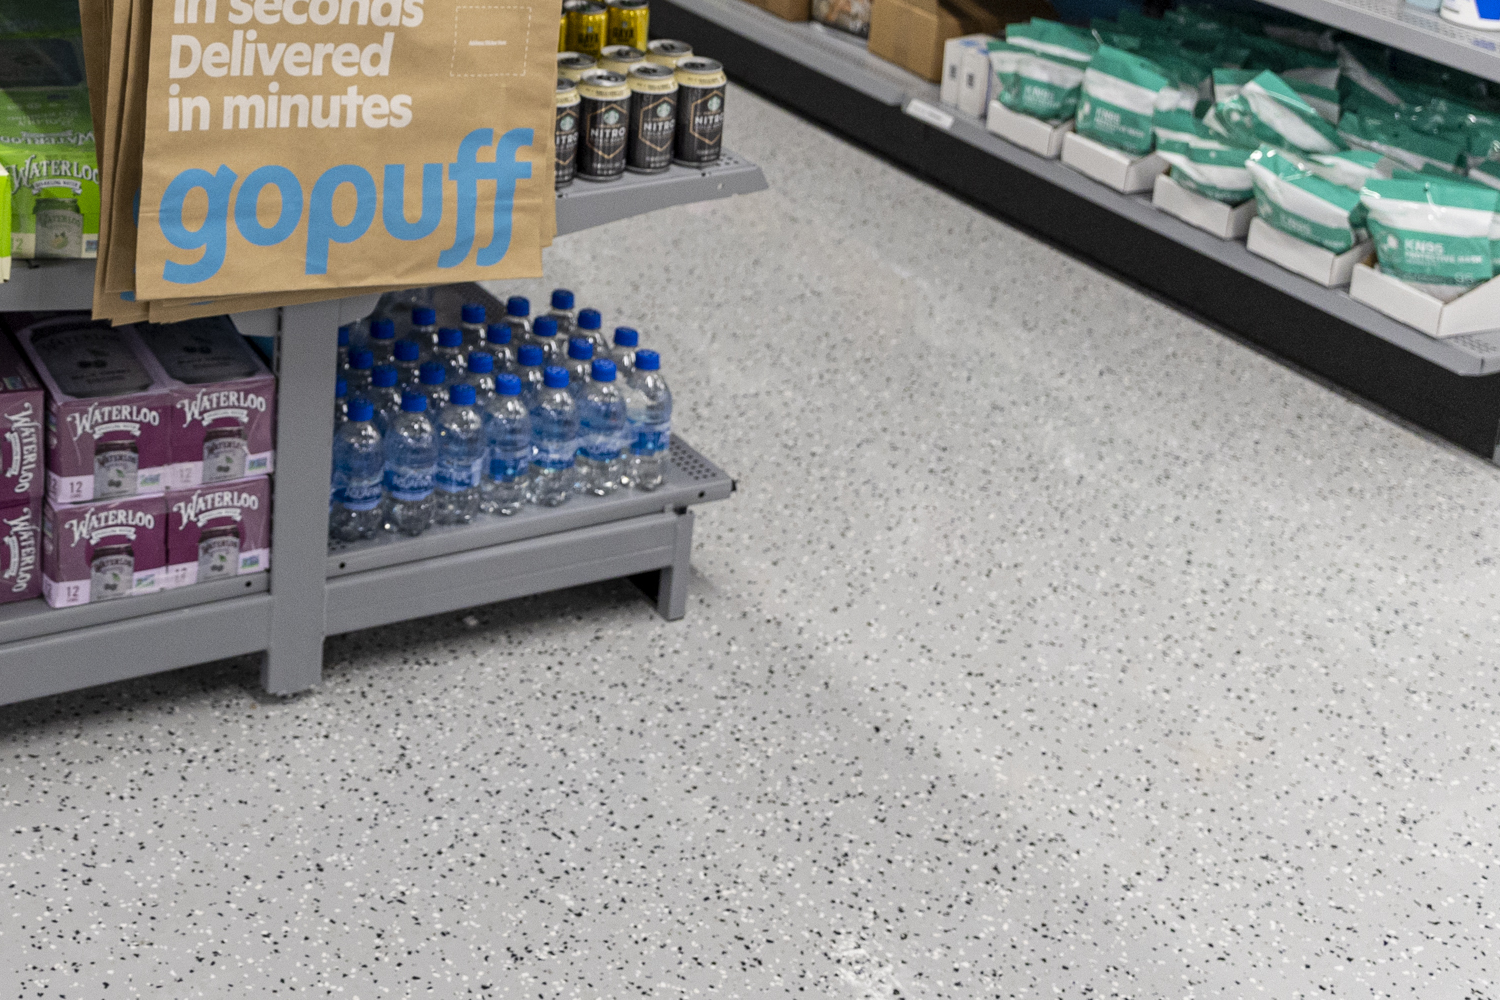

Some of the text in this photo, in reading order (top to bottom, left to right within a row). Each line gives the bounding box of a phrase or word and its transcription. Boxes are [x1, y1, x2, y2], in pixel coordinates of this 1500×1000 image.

[169, 29, 395, 79] Delivered
[168, 81, 413, 132] in minutes
[556, 132, 578, 144] ITRO
[590, 127, 626, 138] NITRO
[158, 127, 535, 285] gopuff
[1404, 239, 1443, 254] KN95
[67, 402, 160, 441] WATERLOO
[176, 388, 266, 428] WATERLOO
[4, 402, 42, 493] WATERLOO
[69, 481, 83, 494] 12
[64, 508, 155, 547] WATERLOO
[173, 490, 259, 530] WATERLOO
[3, 507, 41, 592] WATERLOO
[66, 585, 80, 598] 12
